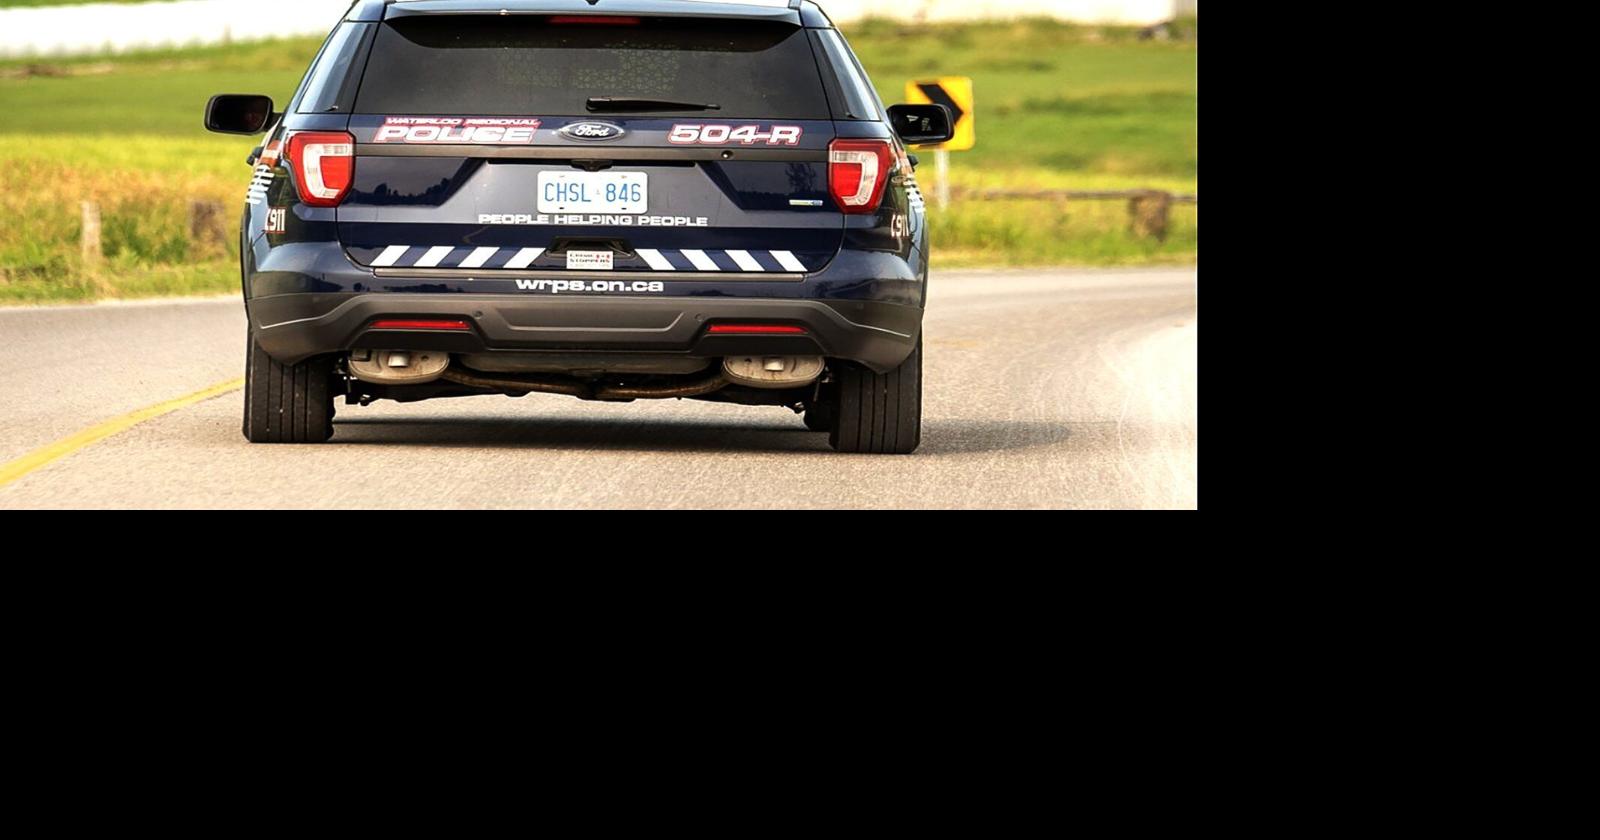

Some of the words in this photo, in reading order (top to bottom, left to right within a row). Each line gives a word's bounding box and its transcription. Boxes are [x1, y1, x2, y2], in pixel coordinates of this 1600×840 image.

[386, 118, 462, 126] WATERLOO
[376, 126, 535, 142] POLICE
[575, 124, 609, 137] Ford
[670, 124, 800, 144] 504-R
[544, 182, 592, 202] CHSL
[605, 183, 641, 202] 846
[478, 214, 549, 225] PEOPLE
[554, 215, 633, 226] HELPING
[638, 216, 708, 227] PEOPLE
[515, 279, 664, 293] wrps.on.ca
